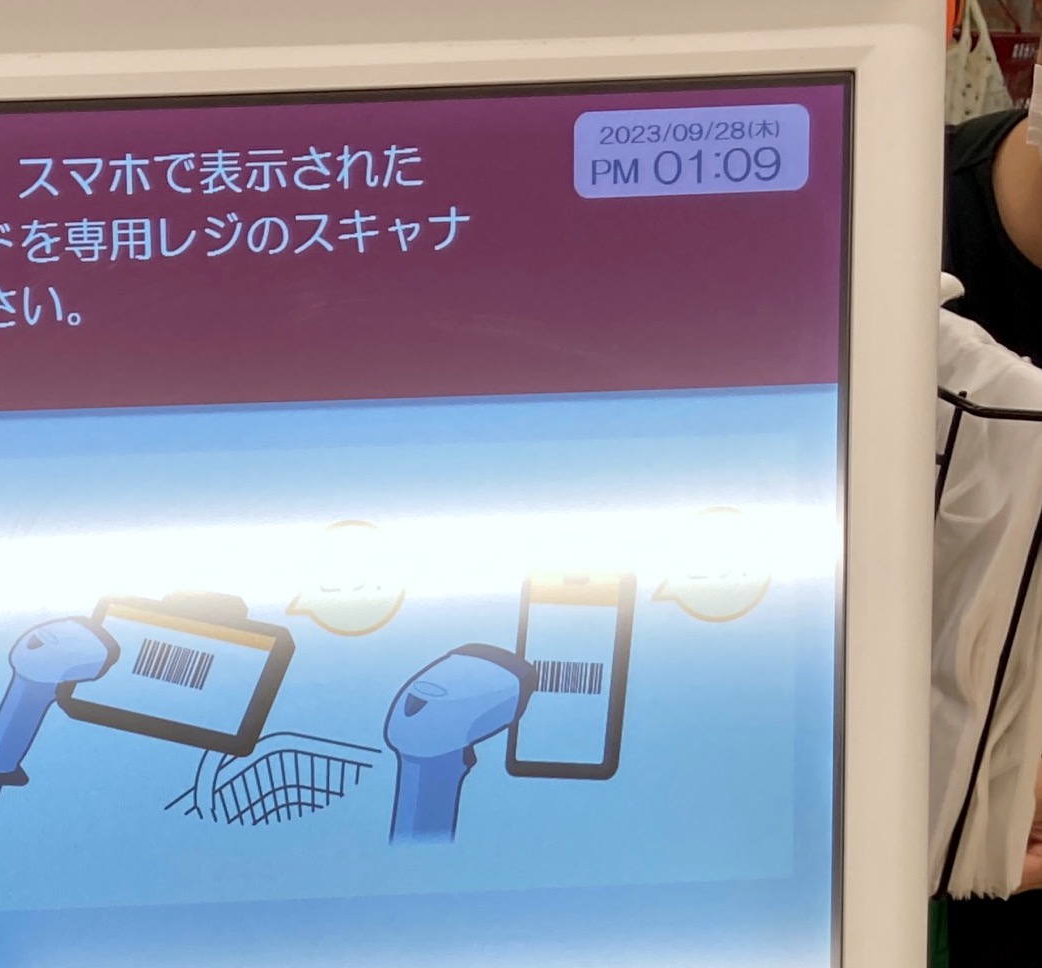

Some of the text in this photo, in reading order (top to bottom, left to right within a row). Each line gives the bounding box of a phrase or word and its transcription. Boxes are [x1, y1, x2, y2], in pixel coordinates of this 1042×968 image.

[599, 120, 781, 145] 2023/09/28(木)
[591, 146, 782, 185] PM 01:09
